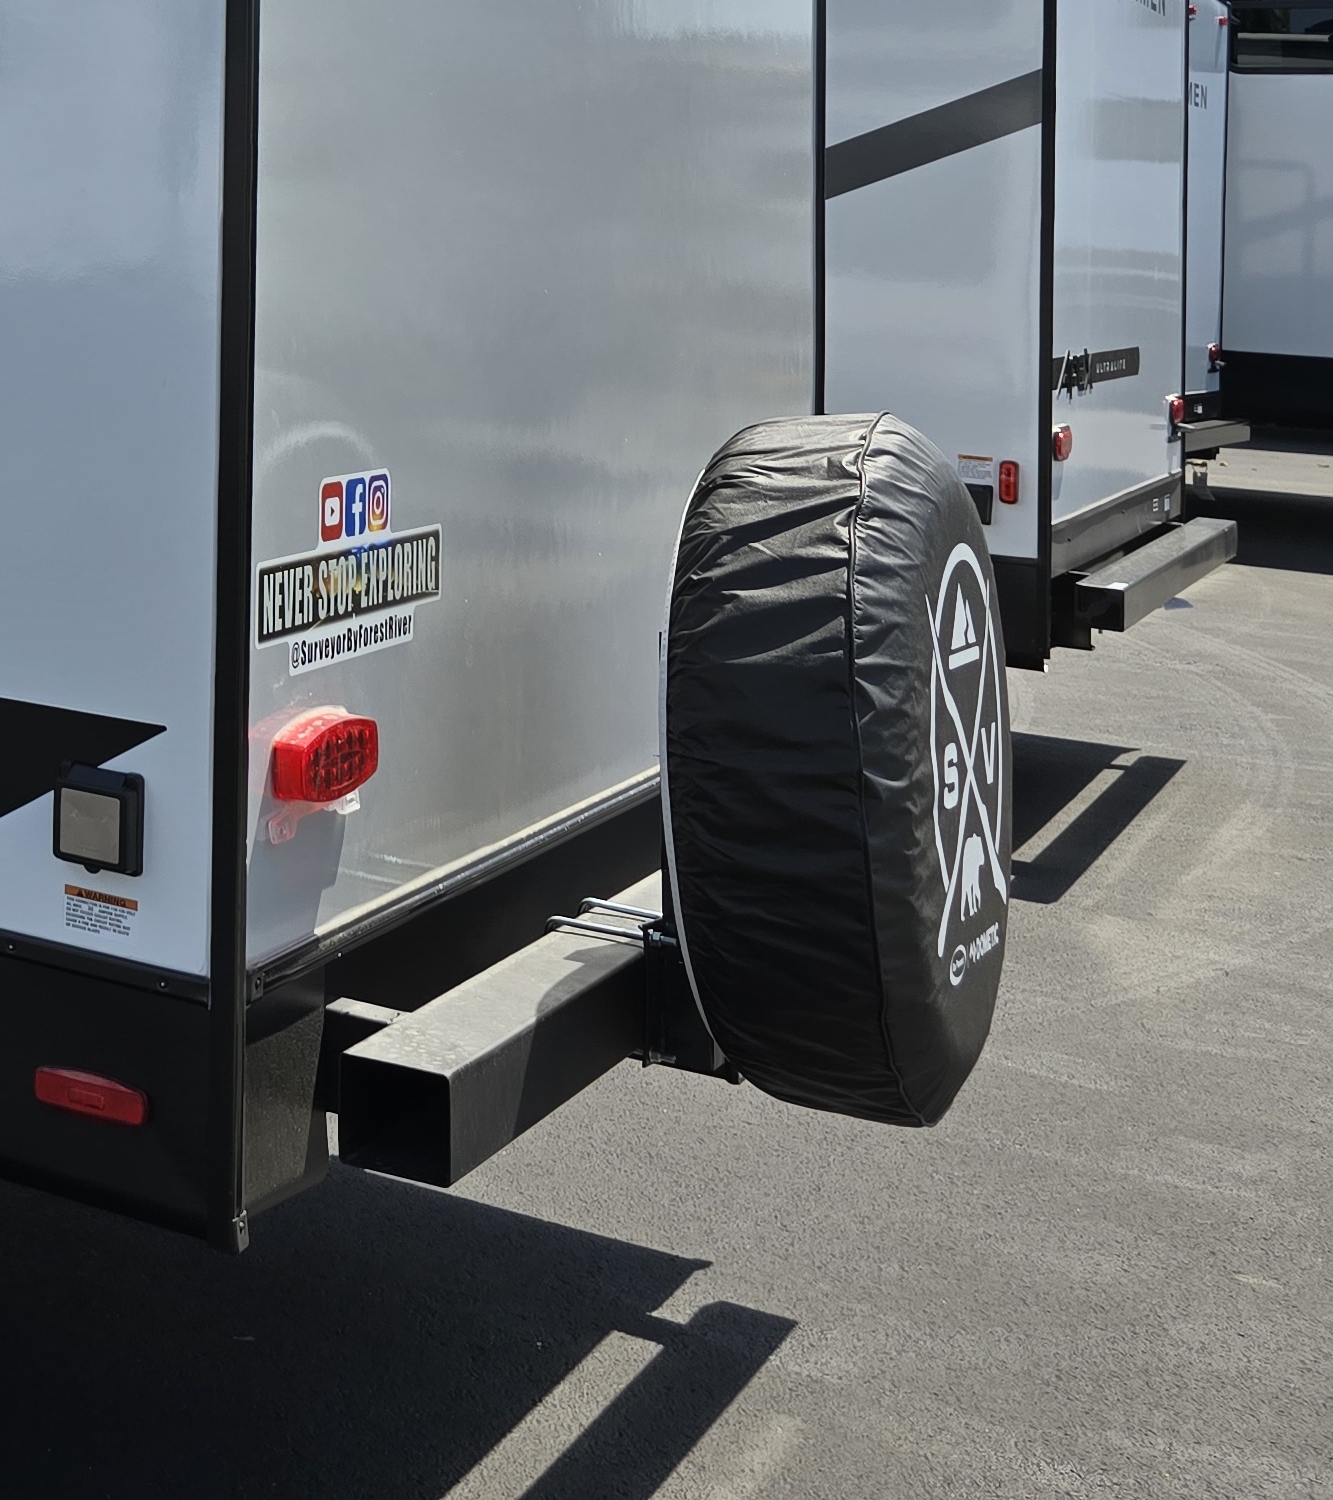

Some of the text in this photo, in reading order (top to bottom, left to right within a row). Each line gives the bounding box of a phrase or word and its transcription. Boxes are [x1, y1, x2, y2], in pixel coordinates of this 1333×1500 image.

[262, 535, 436, 635] NEVER STOP EXPLORING
[291, 614, 412, 668] @SurveyorByForestRiver
[943, 721, 996, 810] S V
[84, 888, 126, 907] WARNING
